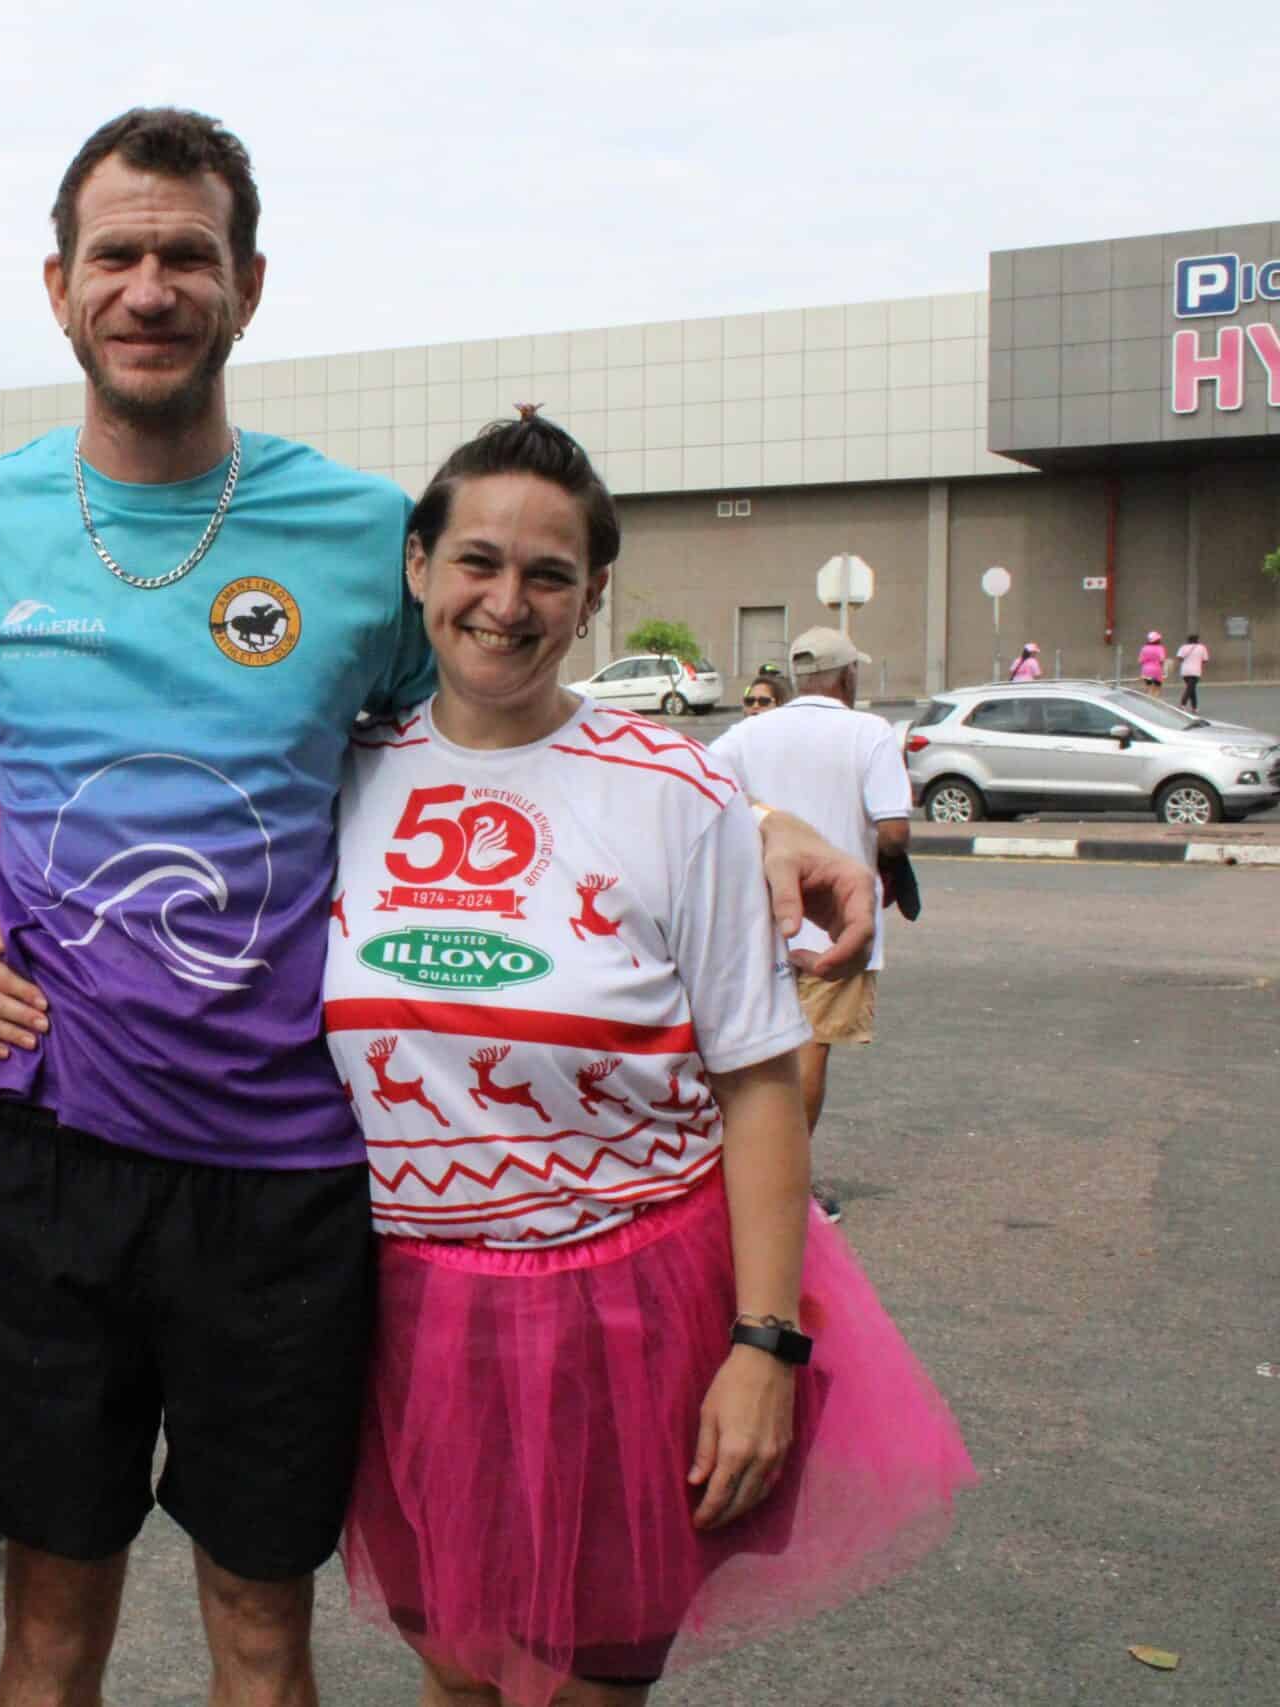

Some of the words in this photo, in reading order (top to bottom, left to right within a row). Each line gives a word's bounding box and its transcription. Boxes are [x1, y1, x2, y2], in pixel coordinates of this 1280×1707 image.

[385, 784, 536, 886] 50
[471, 788, 537, 813] WESTVILLE
[524, 858, 551, 887] CLUB
[423, 932, 488, 945] TRUSTED
[382, 941, 534, 974] ILLOVO
[418, 968, 485, 985] QUALITY
